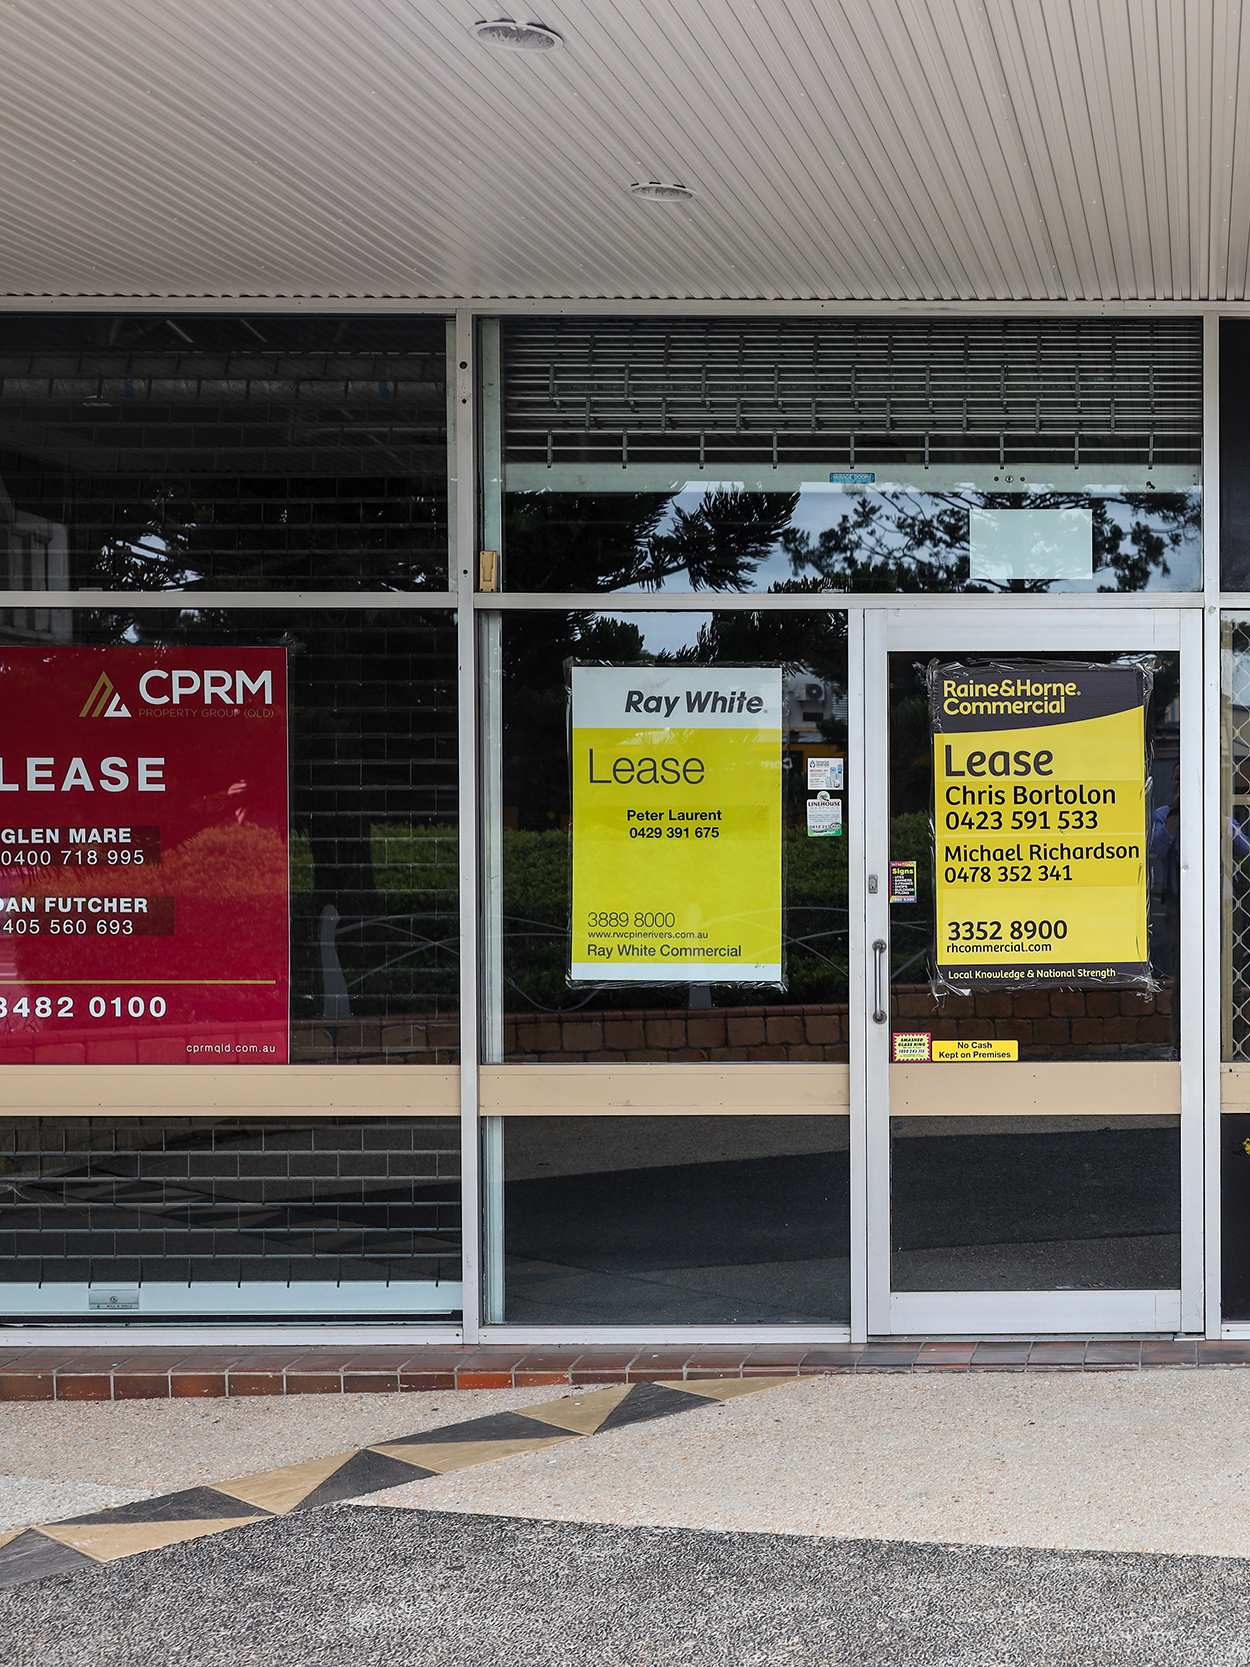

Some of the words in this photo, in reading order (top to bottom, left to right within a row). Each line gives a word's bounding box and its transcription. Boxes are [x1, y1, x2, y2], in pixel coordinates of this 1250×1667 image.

[138, 669, 273, 706] CPRM
[624, 690, 680, 718] Ray
[685, 690, 764, 714] White
[943, 696, 1066, 716] Commercial
[138, 708, 198, 718] PROPERTY
[201, 708, 240, 718] GROUP
[243, 708, 275, 719] (QLD)
[588, 748, 705, 785] Lease
[944, 744, 1054, 778] Lease
[0, 756, 167, 793] LEASE
[945, 785, 1006, 807] Chris
[1013, 784, 1117, 806] Bortolon
[626, 809, 665, 822] Peter
[668, 809, 722, 822] Laurent
[945, 810, 1003, 832] 0423
[1011, 810, 1050, 832] 591
[1058, 810, 1099, 831] 533
[1, 828, 60, 844] GLEN
[69, 828, 132, 844] MARE
[629, 827, 663, 839] 0429
[666, 827, 690, 839] 391
[694, 827, 720, 839] 675
[1, 849, 52, 866] 0400
[61, 849, 98, 866] 718
[107, 849, 145, 866] 995
[944, 844, 1023, 863] Michael
[1029, 842, 1140, 862] Richardson
[944, 866, 992, 884] 0478
[997, 865, 1032, 883] 352
[1037, 864, 1073, 882] 341
[44, 896, 149, 913] FUTCHER
[49, 918, 87, 935] 560
[96, 918, 134, 935] 693
[587, 911, 630, 928] 3889
[633, 911, 676, 928] 8000
[587, 931, 709, 940] www.rwcpinerivers.com.au
[948, 920, 1003, 942] 3352
[1009, 919, 1068, 941] 8900
[587, 944, 614, 960] Ray
[617, 944, 657, 957] White
[659, 944, 742, 957] Commercial
[946, 942, 1053, 954] rhcommercial.com
[948, 969, 974, 980] Local
[975, 968, 1025, 981] Knowledge
[1026, 968, 1035, 979] &
[1036, 968, 1076, 980] National
[1077, 968, 1117, 980] Strength
[89, 996, 168, 1018] 0100
[186, 1042, 277, 1055] cprmqld.com.au
[938, 1051, 958, 1059] Kept
